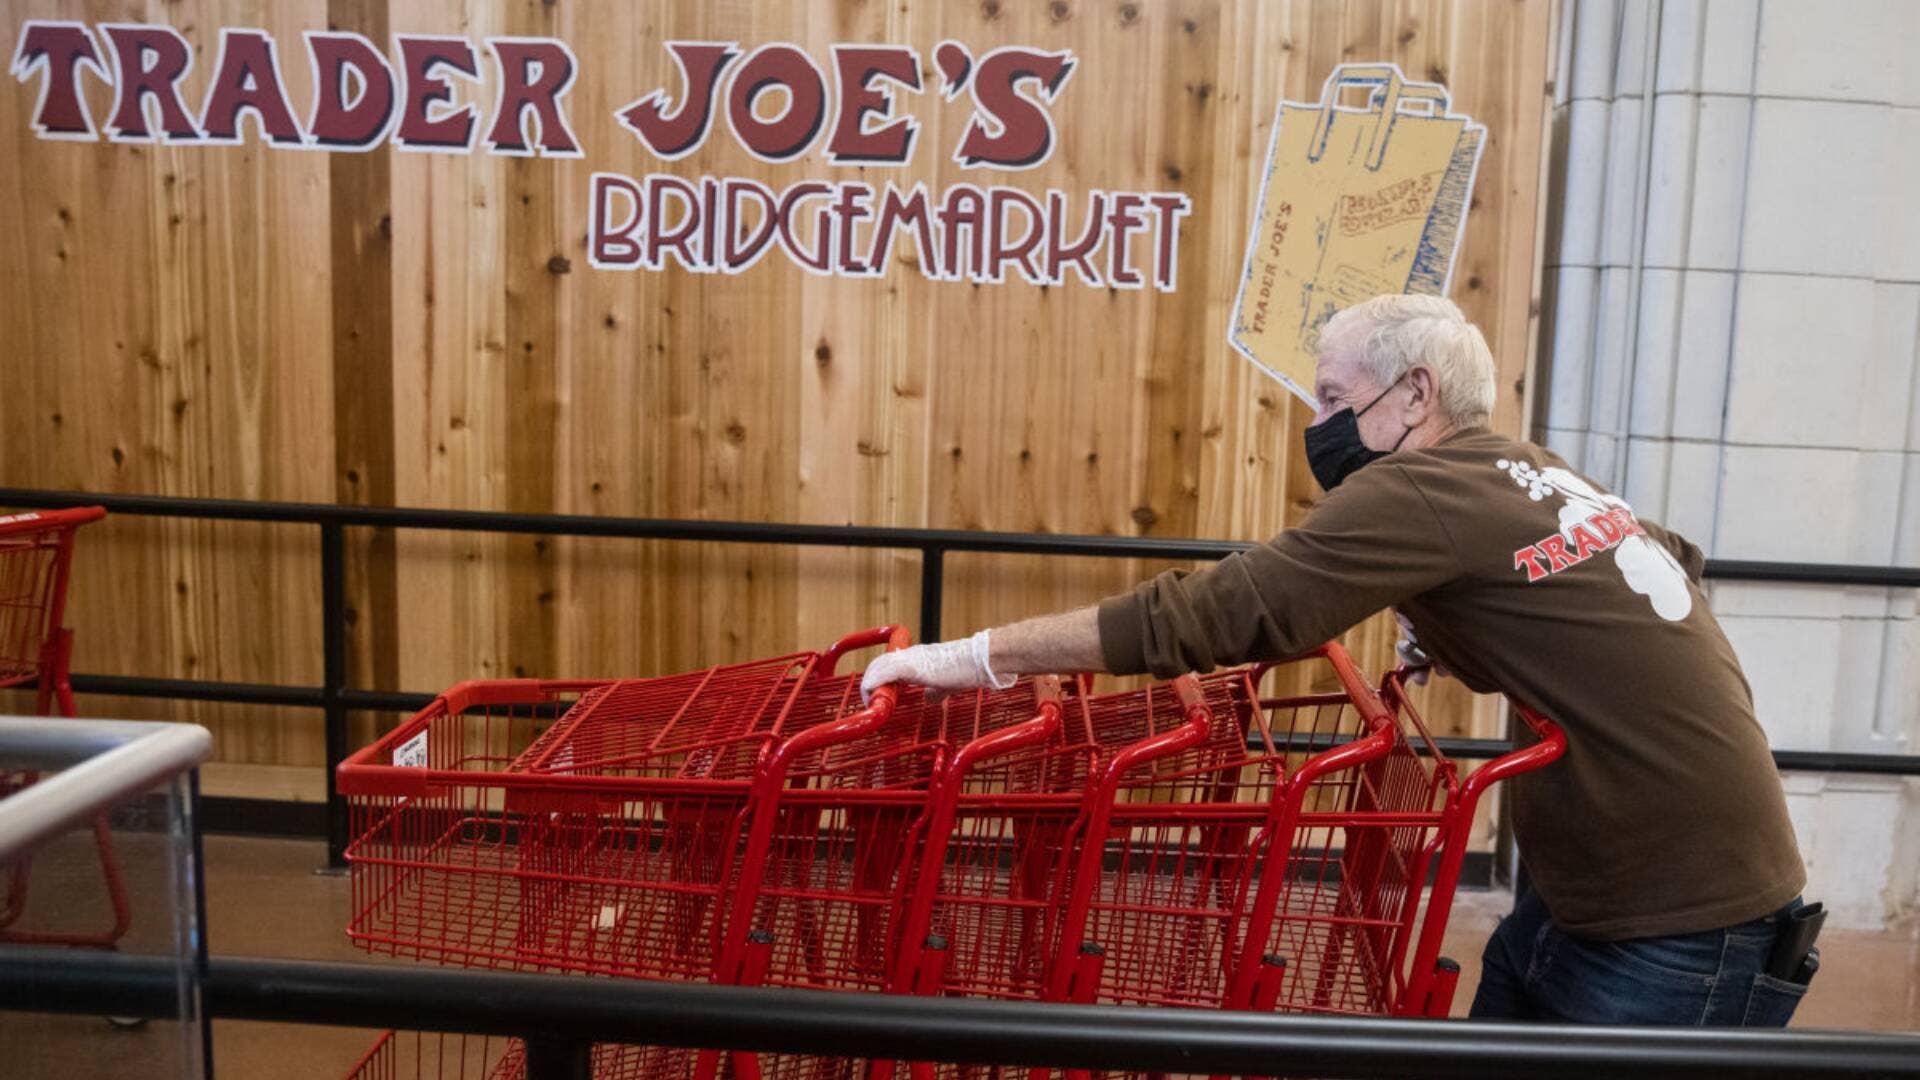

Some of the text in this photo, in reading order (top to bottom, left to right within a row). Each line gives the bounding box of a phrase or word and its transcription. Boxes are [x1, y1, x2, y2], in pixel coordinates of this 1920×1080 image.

[11, 20, 1077, 170] TRADER JOE'S
[588, 172, 1191, 291] BRIDGEMARKET
[1253, 201, 1292, 334] TRADER JOE'S
